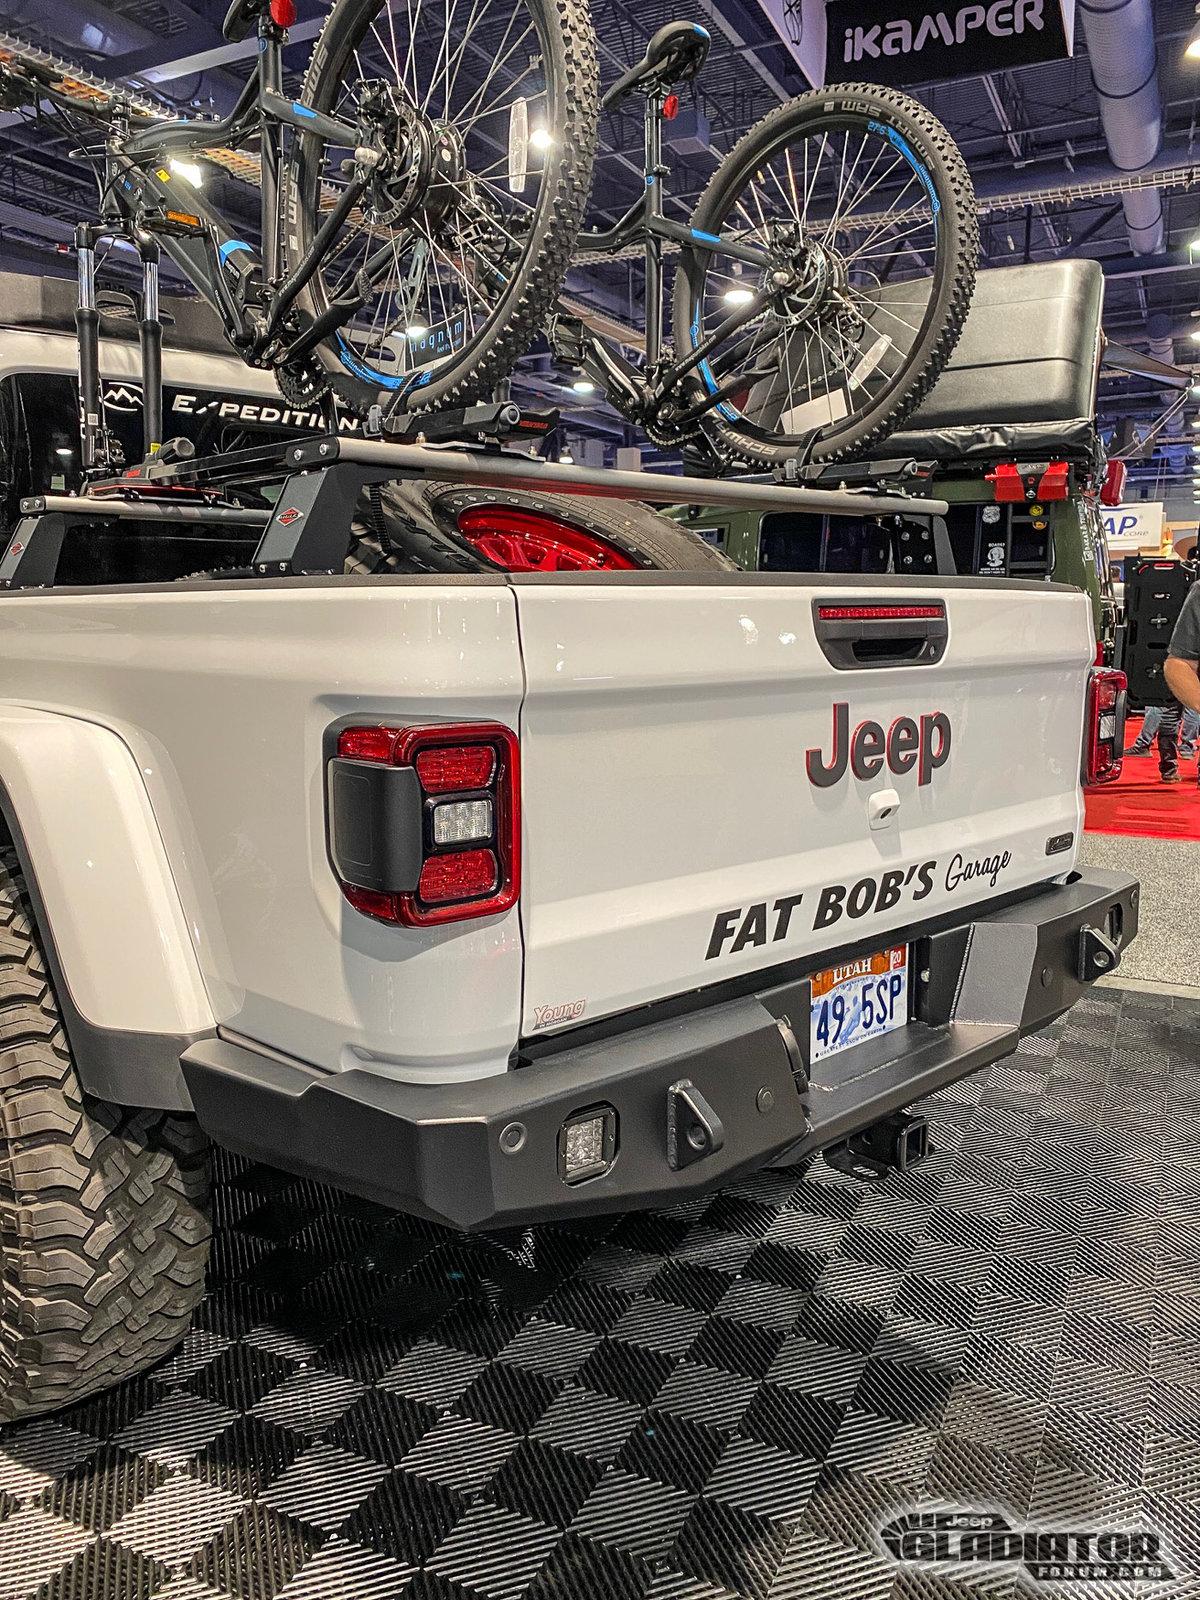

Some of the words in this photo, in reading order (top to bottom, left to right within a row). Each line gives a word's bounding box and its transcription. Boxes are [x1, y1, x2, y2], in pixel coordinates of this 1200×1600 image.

[806, 702, 951, 788] Jeep
[705, 894, 803, 960] FAT
[812, 860, 937, 931] BOB'S
[945, 850, 1012, 891] Garage
[832, 957, 873, 984] UTAH
[892, 950, 902, 964] 20
[534, 999, 586, 1024] Young
